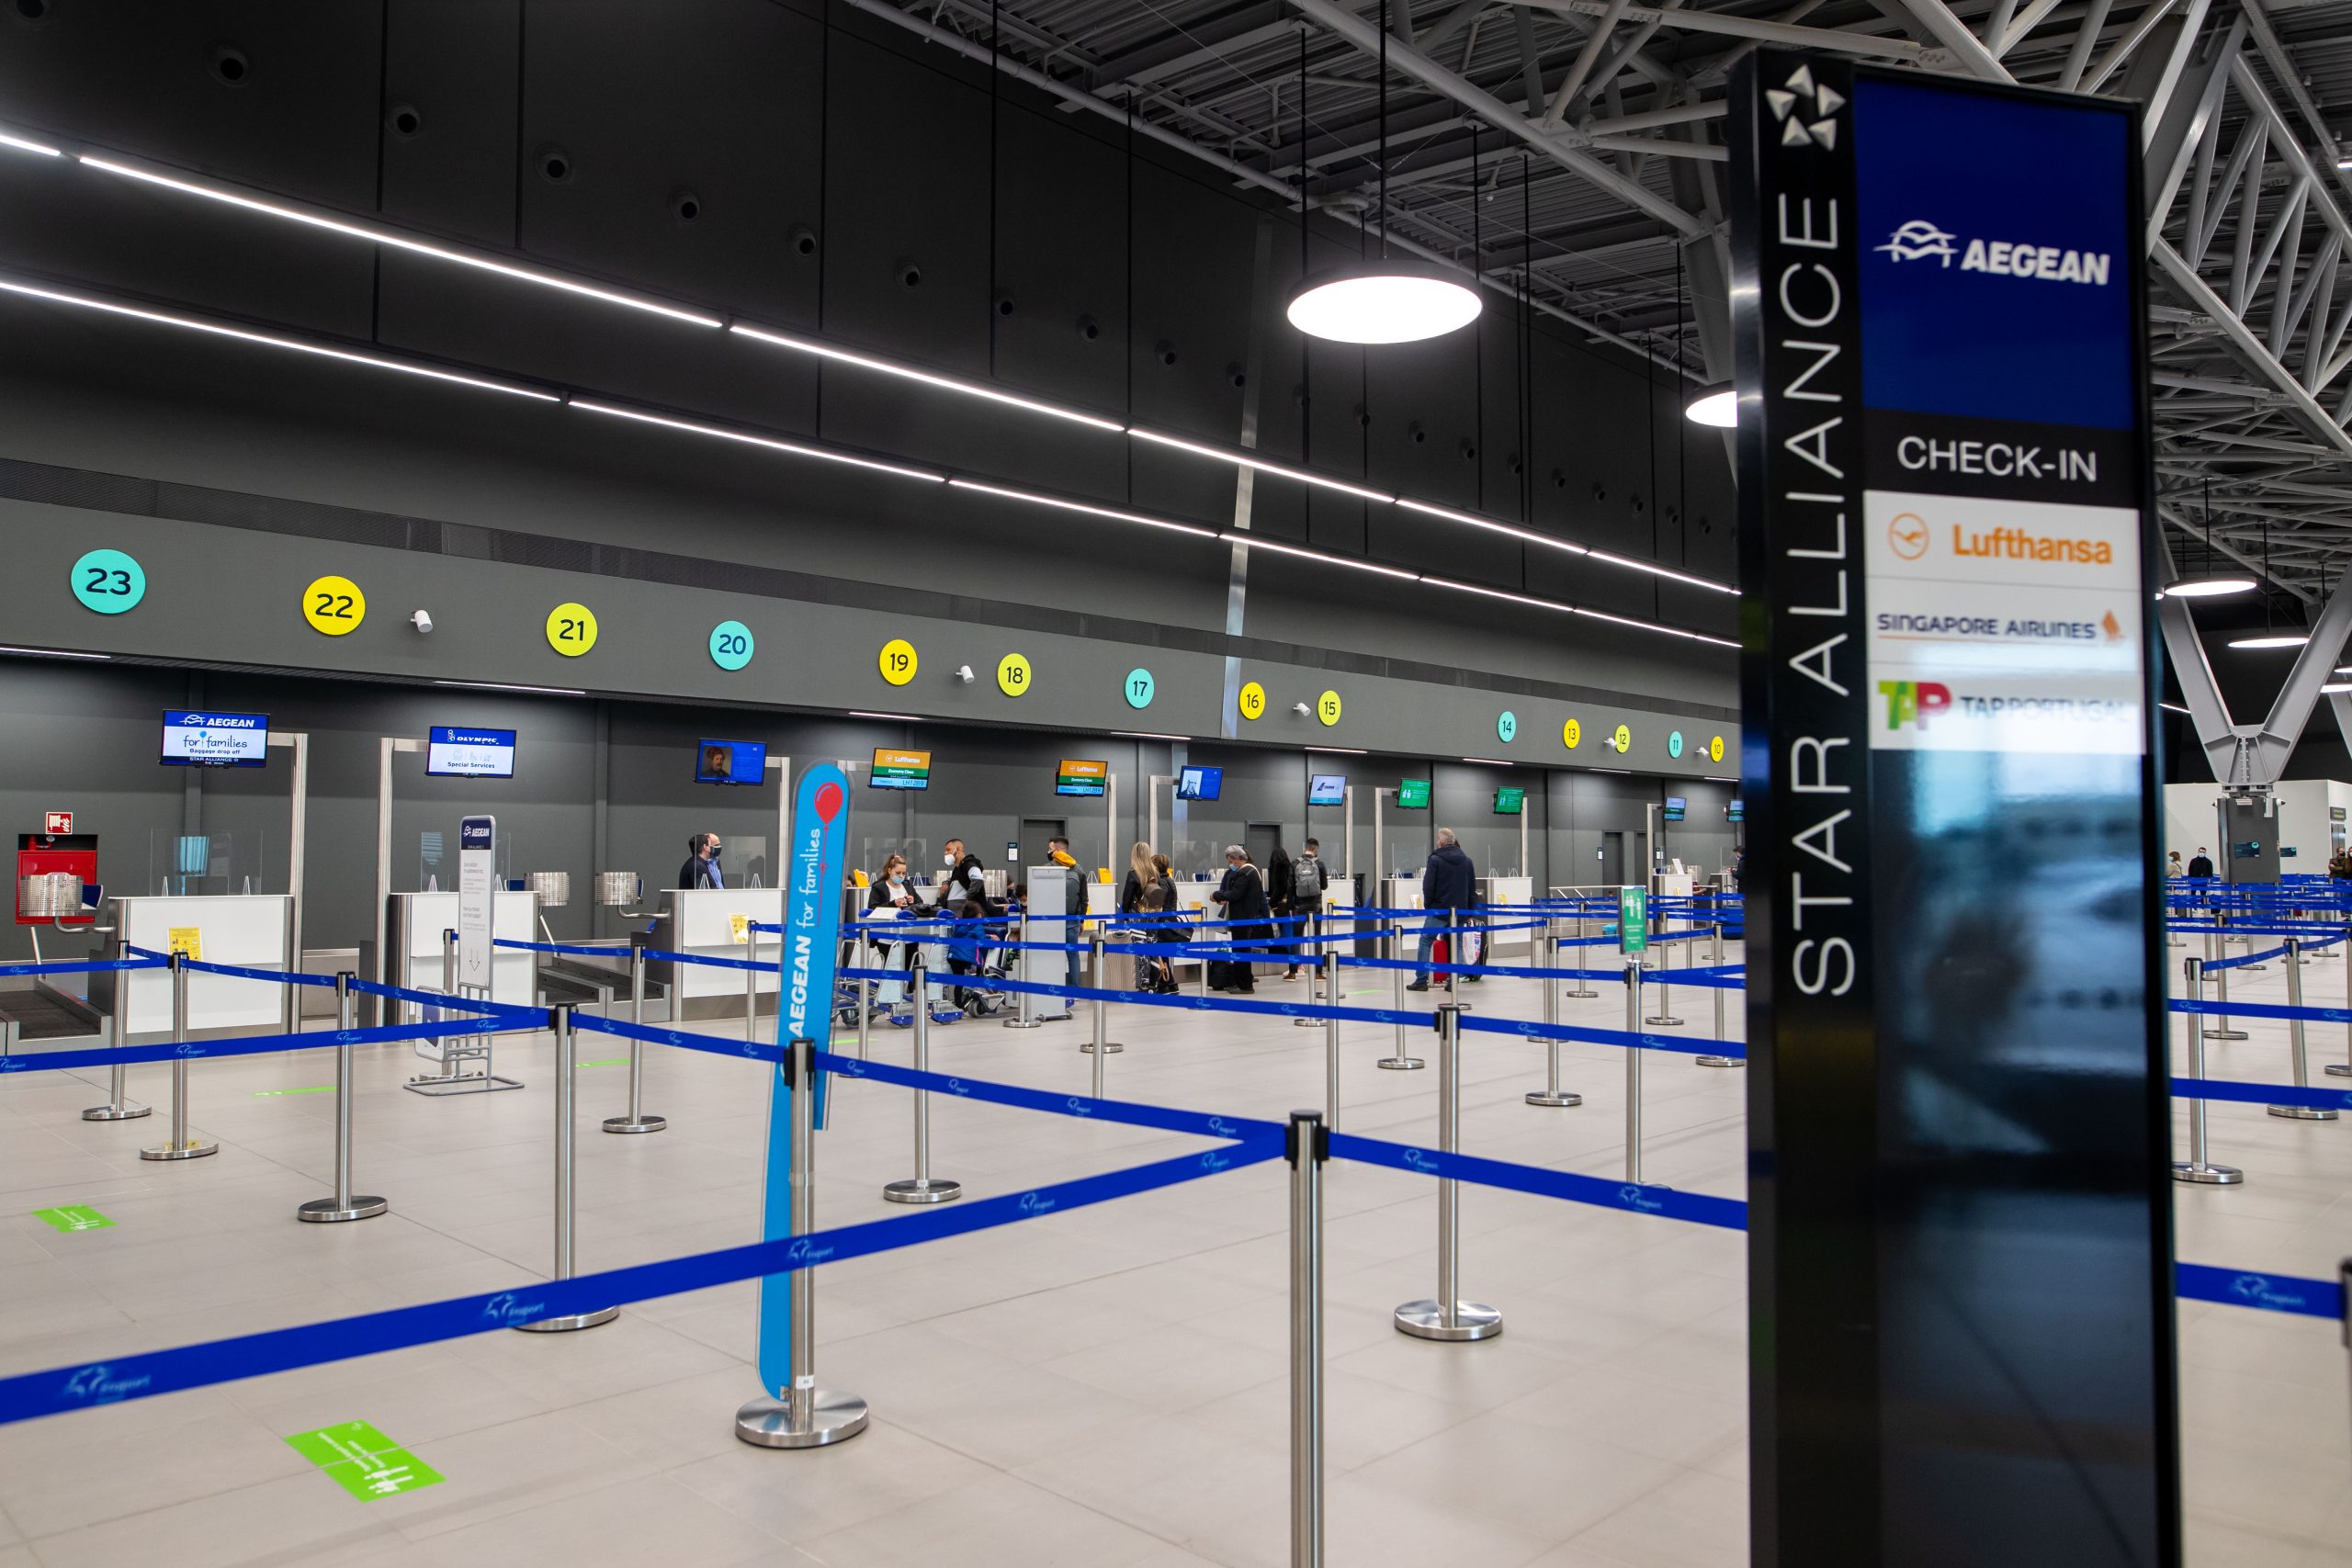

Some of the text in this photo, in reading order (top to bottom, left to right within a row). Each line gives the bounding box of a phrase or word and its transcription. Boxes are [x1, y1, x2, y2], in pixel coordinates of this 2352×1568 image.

[1961, 239, 2110, 286] AEGEAN
[1896, 436, 2098, 483] CHECK-IN
[1952, 523, 2113, 565] Lufthansa
[85, 567, 131, 597] 23
[1778, 192, 1856, 997] STAR ALLIANCE
[315, 593, 354, 619] 22
[559, 618, 585, 642] 21
[1877, 614, 2097, 638] SINGAPORE AIRLINES
[718, 635, 747, 655] 20
[889, 653, 909, 672] 19
[1006, 666, 1023, 684] 18
[1133, 681, 1148, 696] 17
[1247, 694, 1259, 709] 16
[1324, 701, 1336, 716] 15
[1878, 680, 1952, 730] TAP
[1960, 695, 2005, 719] TAP
[207, 718, 254, 728] AEGEAN
[1502, 721, 1511, 733] 14
[184, 735, 247, 748] for families
[1567, 728, 1576, 739] 13
[1619, 734, 1626, 744] 12
[1673, 739, 1679, 750] 11
[1714, 744, 1720, 754] 10
[472, 827, 490, 837] AEGEAN
[787, 829, 820, 1038] AEGEAN for families
